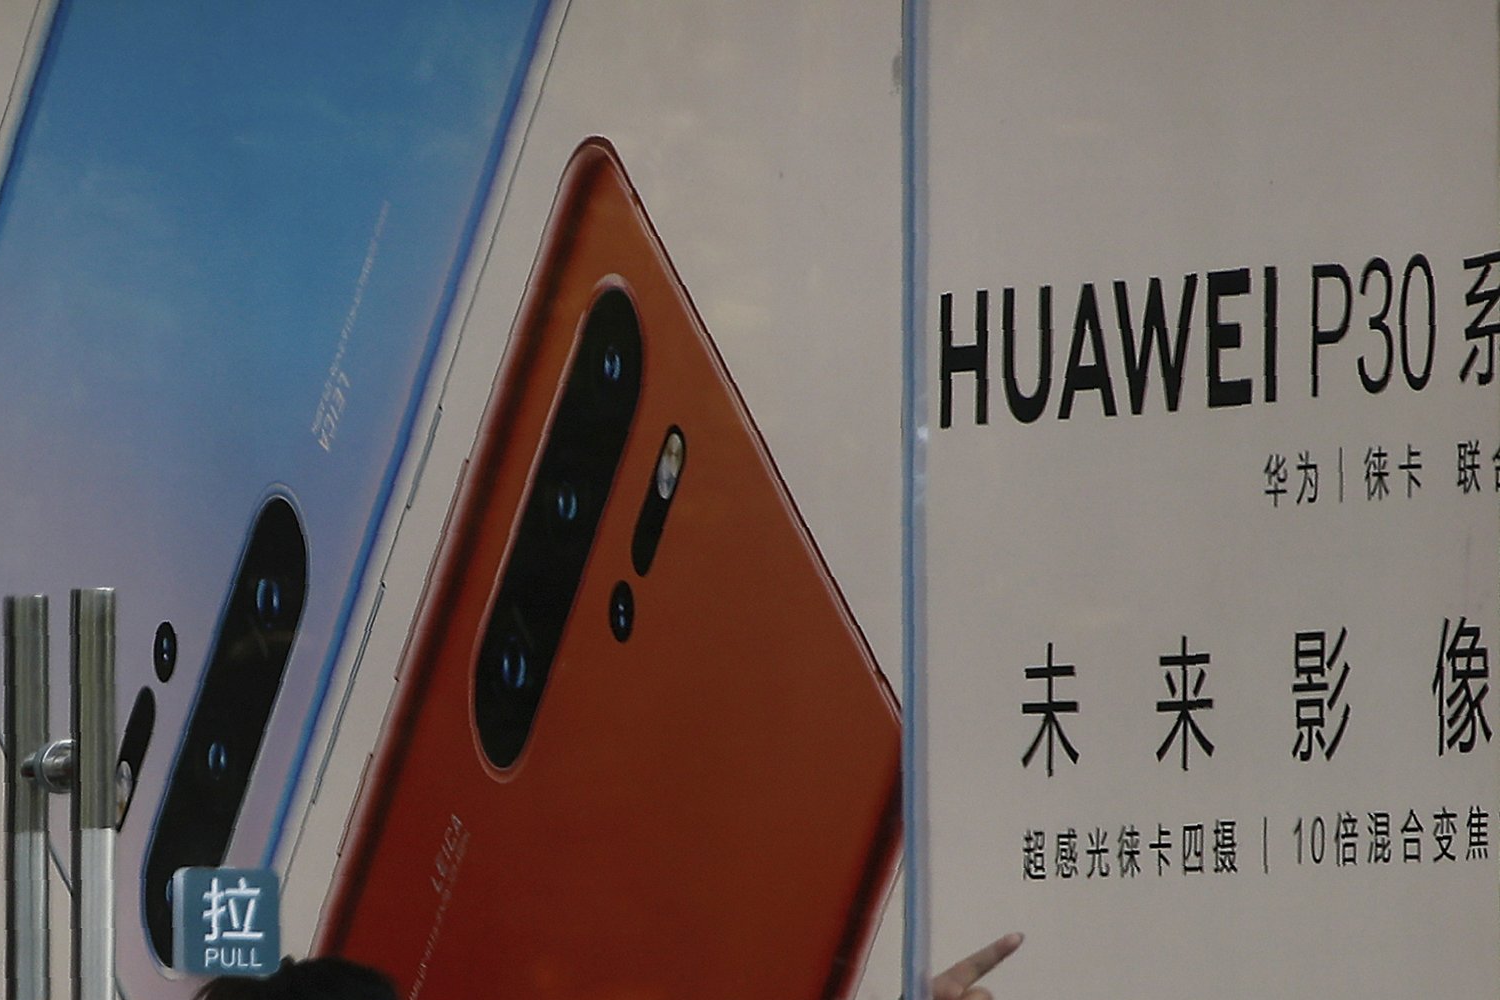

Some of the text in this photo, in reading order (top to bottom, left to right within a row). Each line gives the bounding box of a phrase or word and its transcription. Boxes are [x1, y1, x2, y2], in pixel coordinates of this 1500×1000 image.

[939, 265, 1278, 430] HUAWEI
[1311, 253, 1436, 398] P30
[1264, 451, 1319, 507] 华为
[1364, 443, 1423, 502] 徕卡
[1021, 616, 1493, 778] 未来影像
[1022, 804, 1490, 882] 超感光徕卡四摄 10倍混合变焦
[202, 876, 265, 942] 拉
[204, 947, 263, 968] PULL
